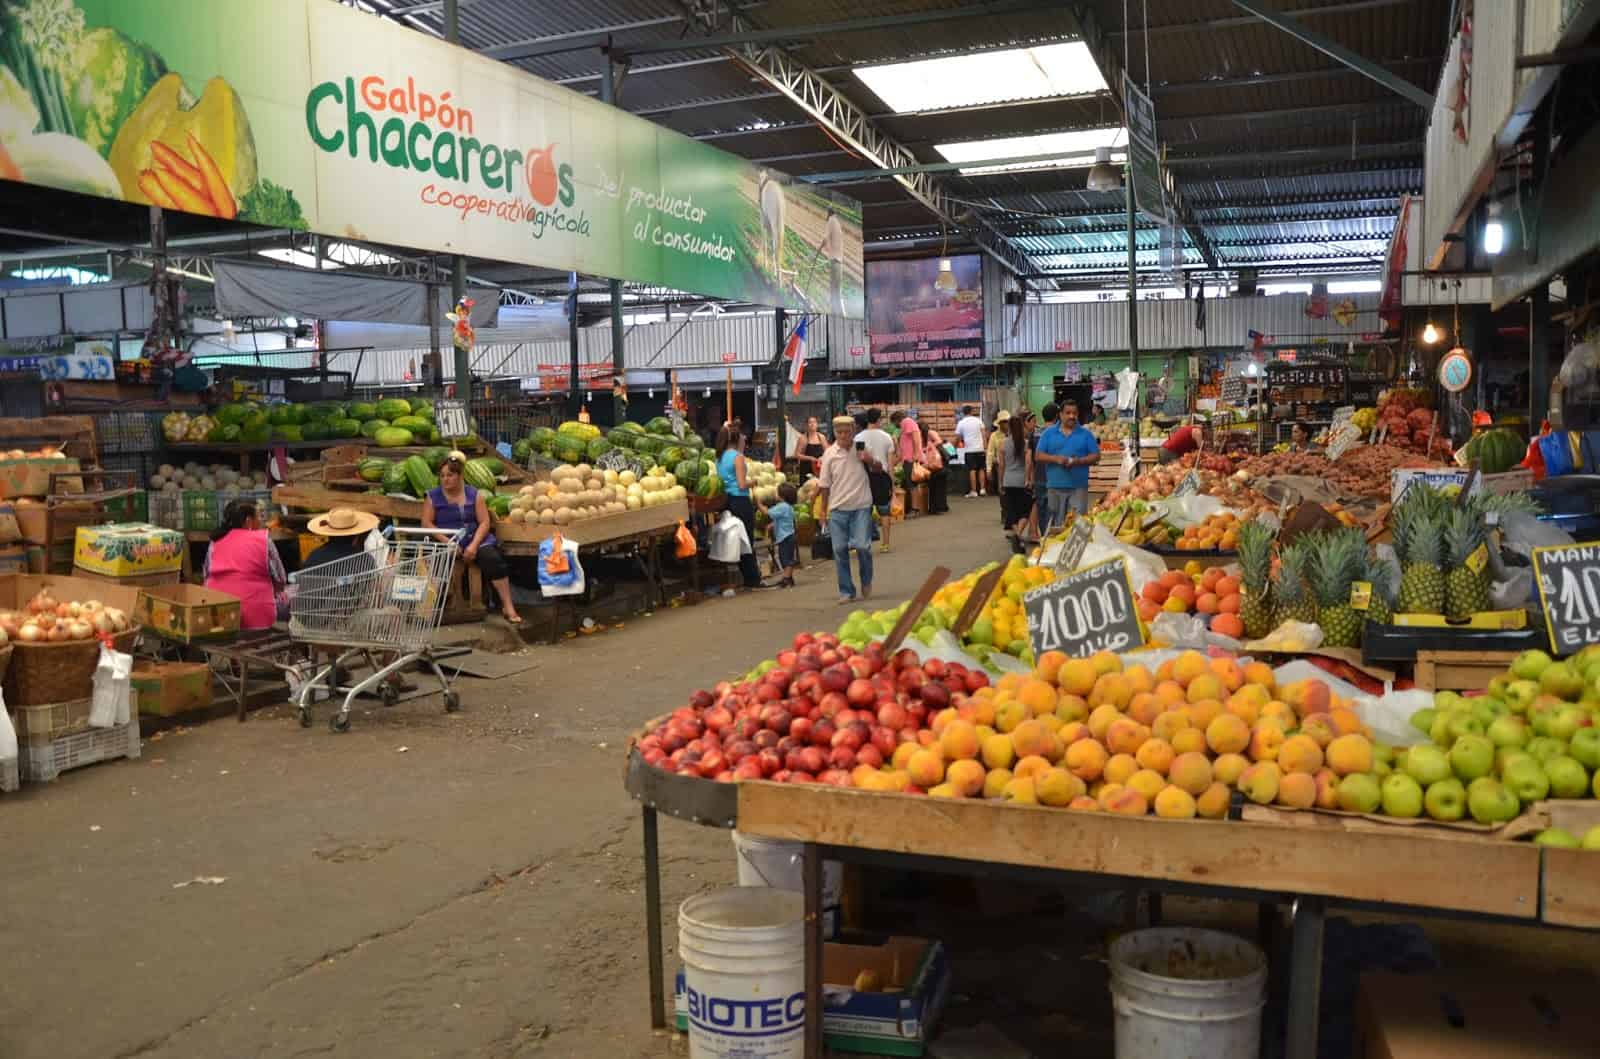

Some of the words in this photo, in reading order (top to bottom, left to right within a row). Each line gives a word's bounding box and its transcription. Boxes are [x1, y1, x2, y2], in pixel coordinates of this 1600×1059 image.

[361, 75, 473, 133] Galpón
[306, 76, 575, 207] Chacareros
[625, 185, 707, 224] productor
[633, 212, 651, 241] al
[652, 232, 736, 263] consumidor
[1543, 546, 1600, 564] MAN
